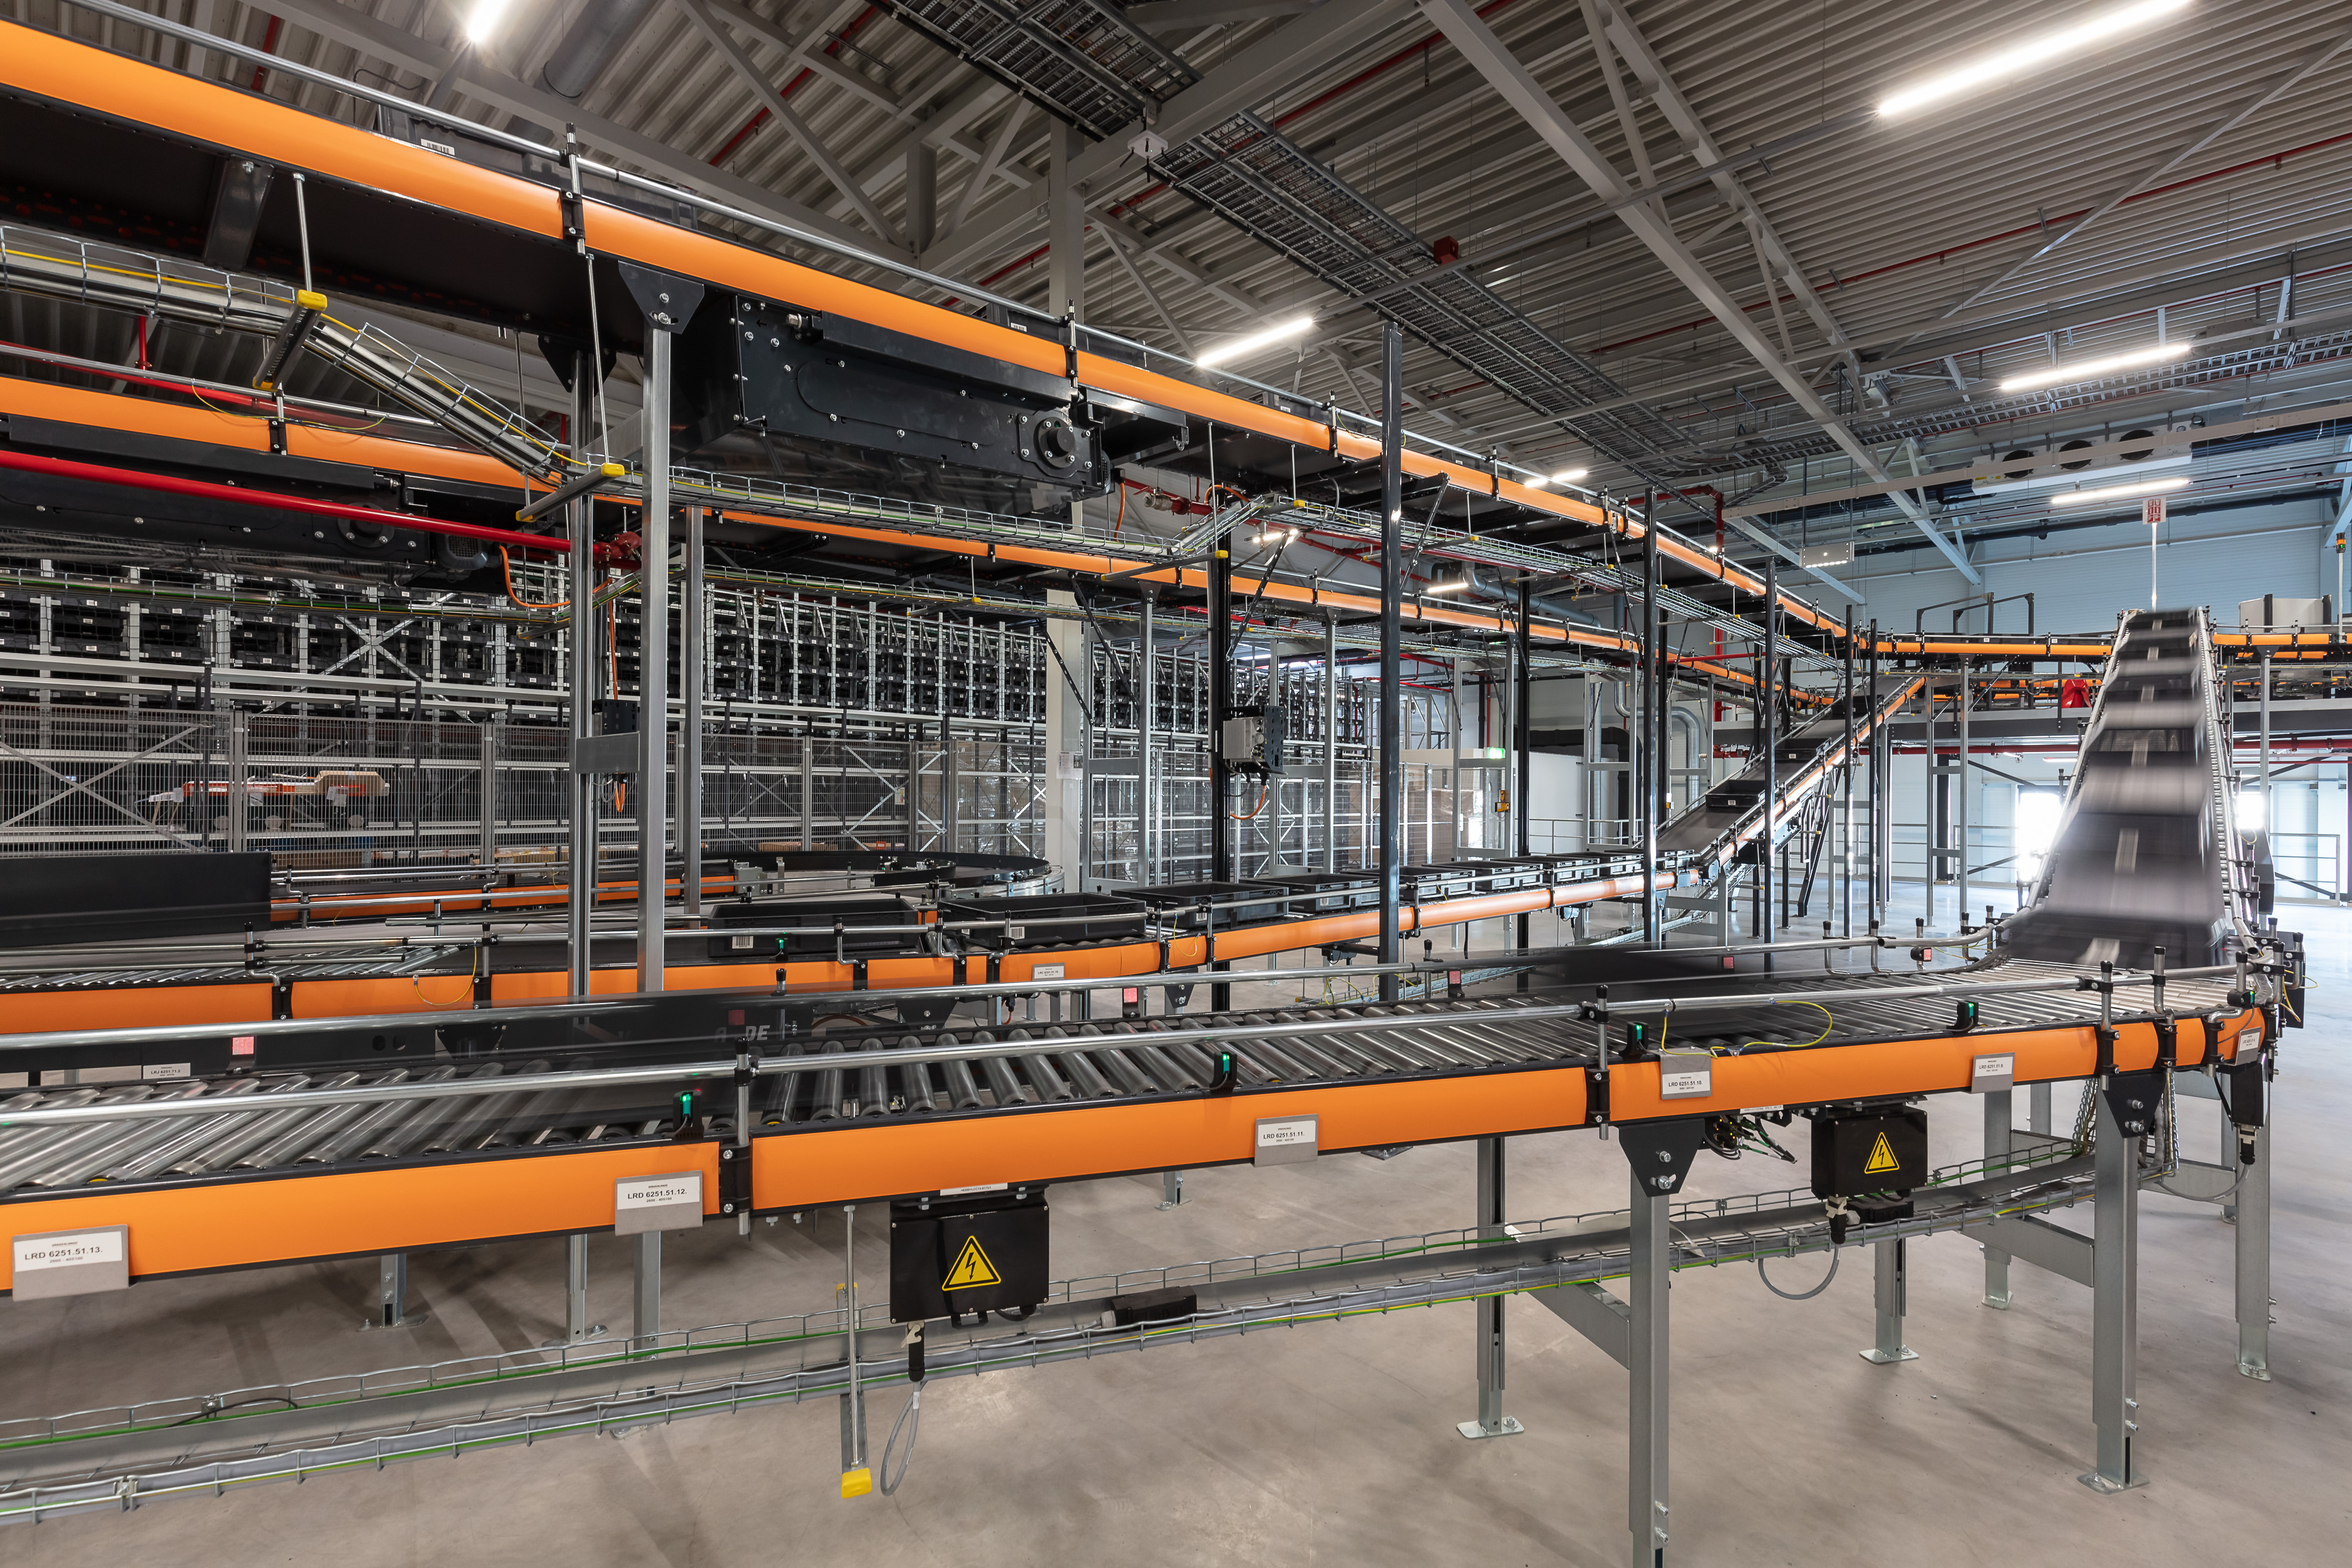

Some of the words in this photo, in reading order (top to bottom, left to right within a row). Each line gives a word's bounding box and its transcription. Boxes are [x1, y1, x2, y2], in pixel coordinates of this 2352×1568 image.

[646, 1188, 687, 1198] 6251.51.12.
[25, 1252, 46, 1260] LRD
[49, 1246, 103, 1258] 6251.51.13.
